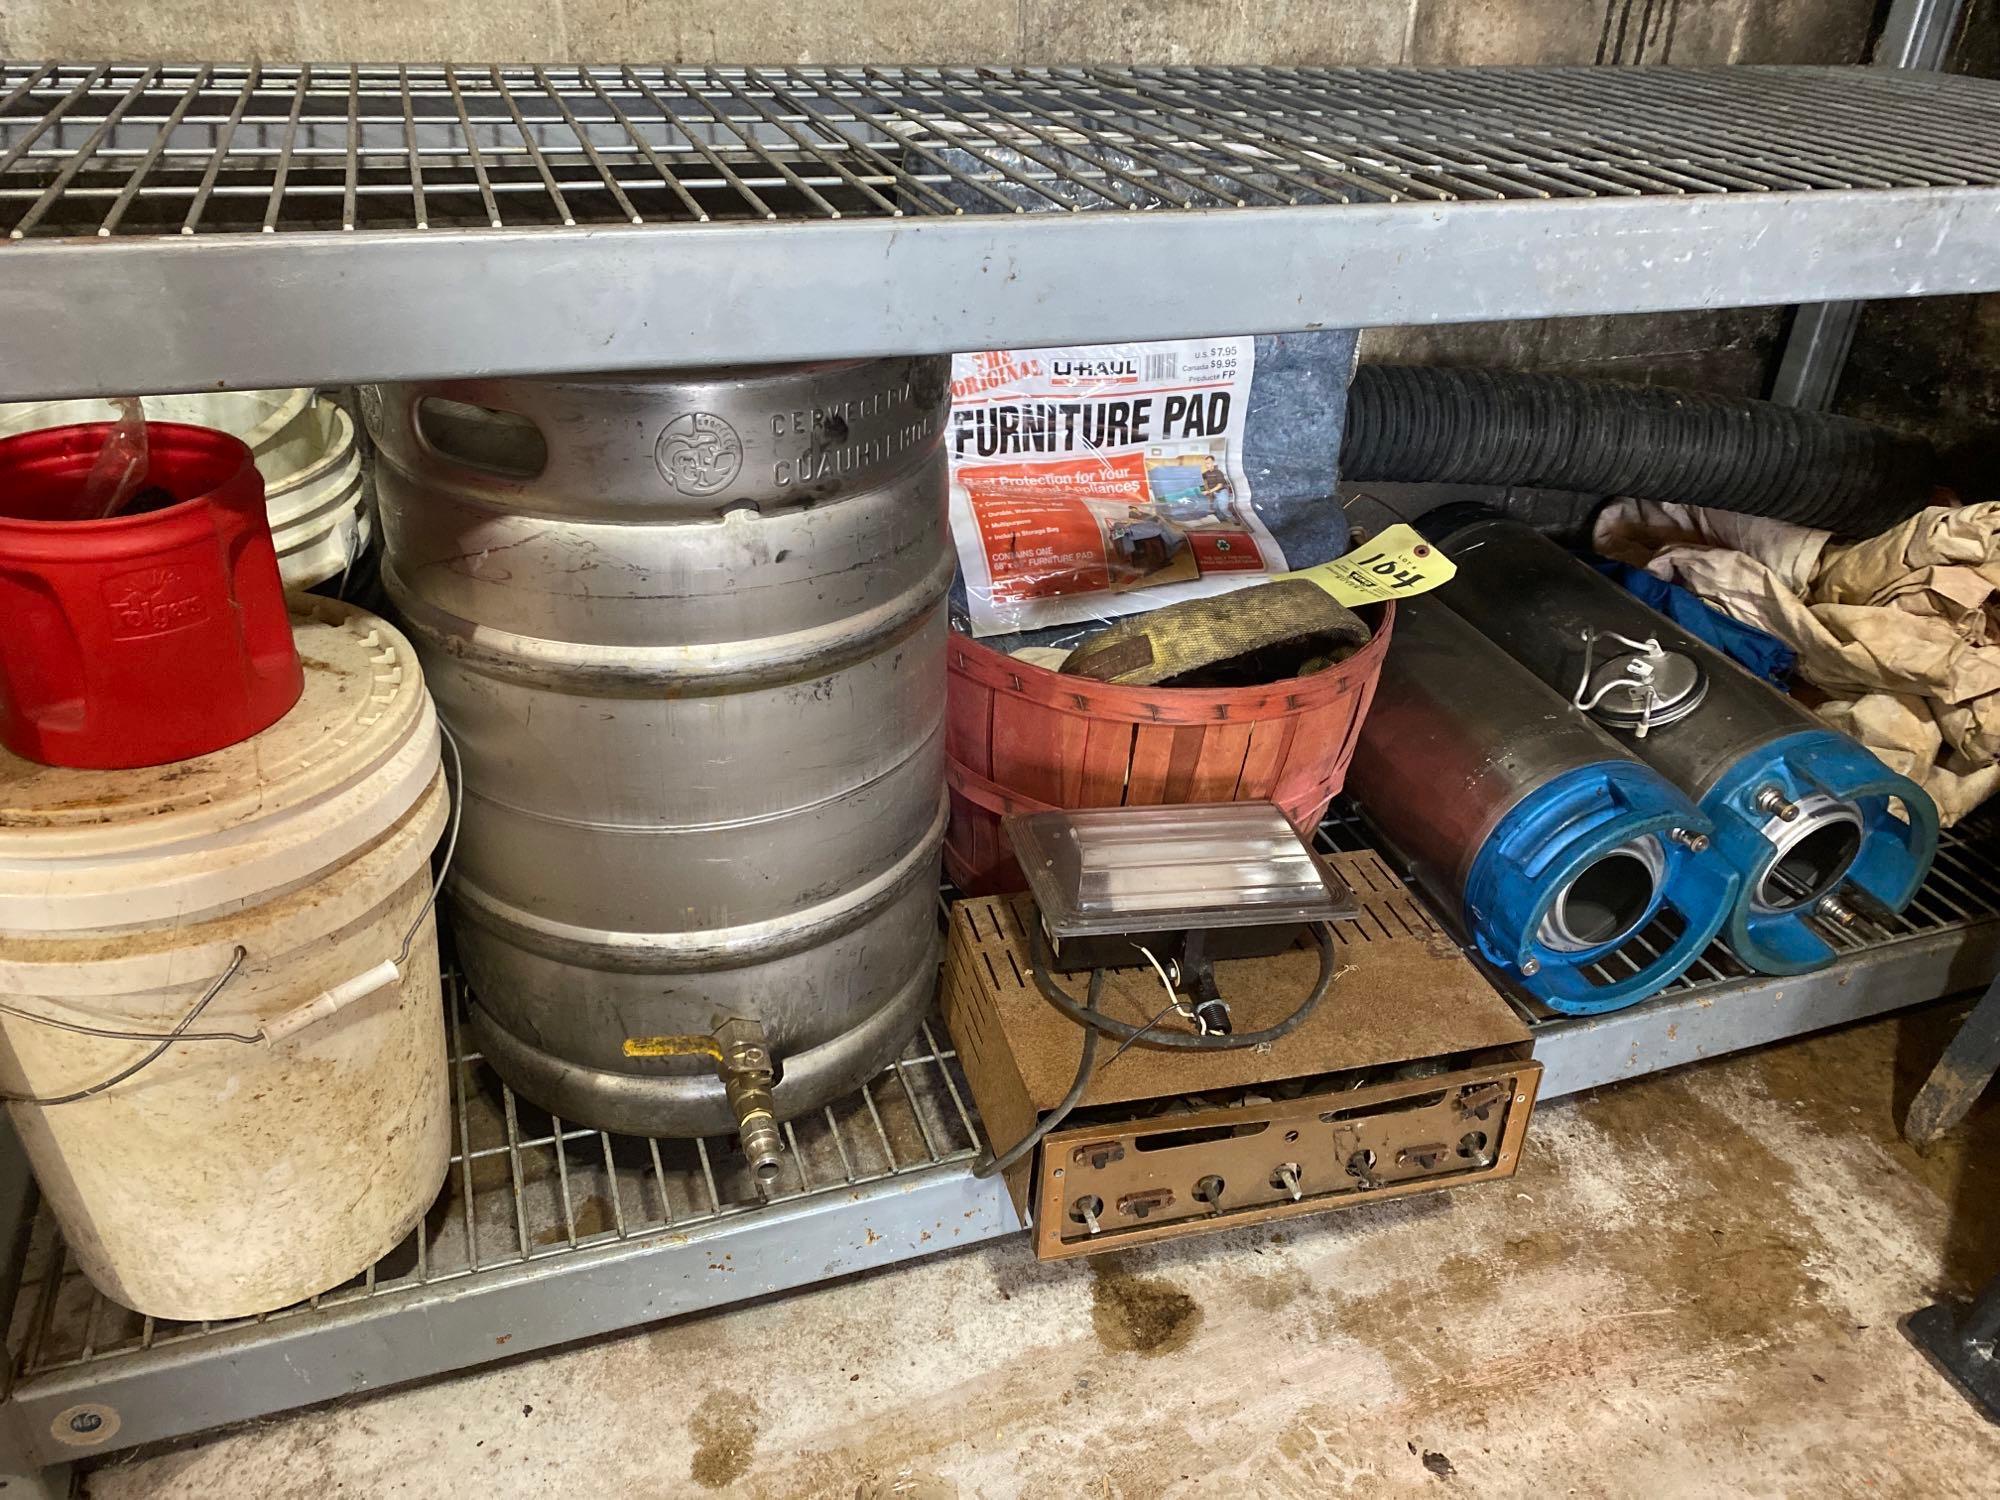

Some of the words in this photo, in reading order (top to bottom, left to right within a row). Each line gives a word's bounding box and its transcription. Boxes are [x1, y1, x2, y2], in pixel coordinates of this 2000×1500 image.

[1210, 346, 1237, 357] $7.95
[972, 351, 1013, 374] THE
[1054, 360, 1137, 376] U-HAUL
[1182, 364, 1209, 372] Canada
[1210, 358, 1237, 369] $9.95
[952, 359, 1043, 398] ORIGINAL
[1222, 370, 1236, 379] FP
[953, 398, 1153, 459] FURNITURE
[1162, 391, 1231, 440] PAD
[999, 473, 1072, 487] Protection
[1075, 470, 1096, 484] for
[1100, 467, 1131, 480] Your
[994, 532, 1021, 540] Includs
[1028, 554, 1074, 567] FURNITURE
[1075, 551, 1093, 560] PAD
[1035, 546, 1053, 556] ONE
[1358, 553, 1426, 588] 104
